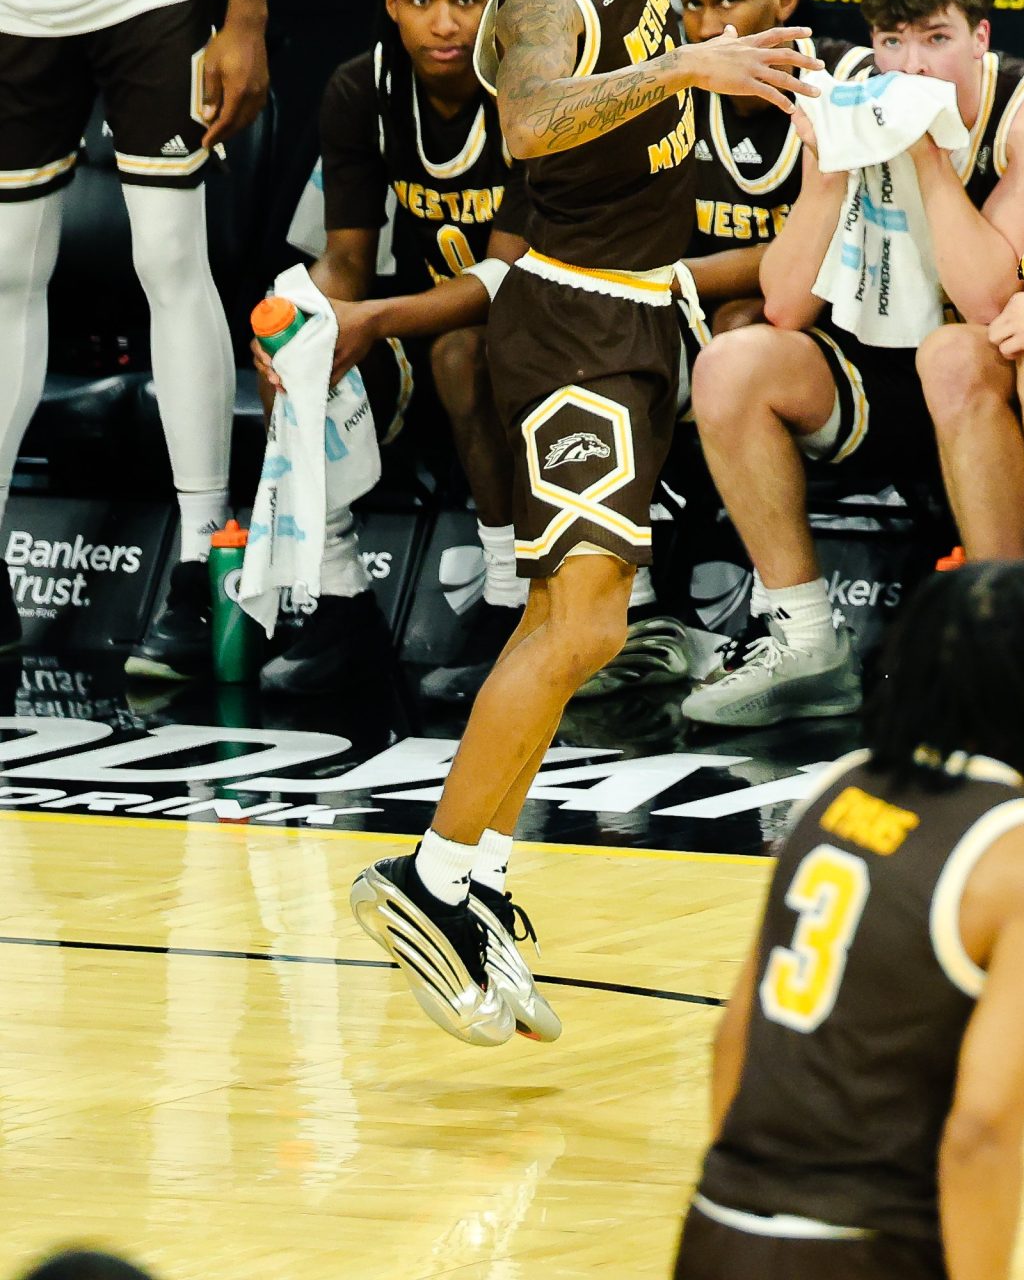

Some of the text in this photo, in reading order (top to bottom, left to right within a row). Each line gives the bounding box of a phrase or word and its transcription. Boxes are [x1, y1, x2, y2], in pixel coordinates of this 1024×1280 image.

[5, 530, 143, 574] Bankers
[824, 570, 902, 607] kers
[759, 843, 871, 1034] 3
